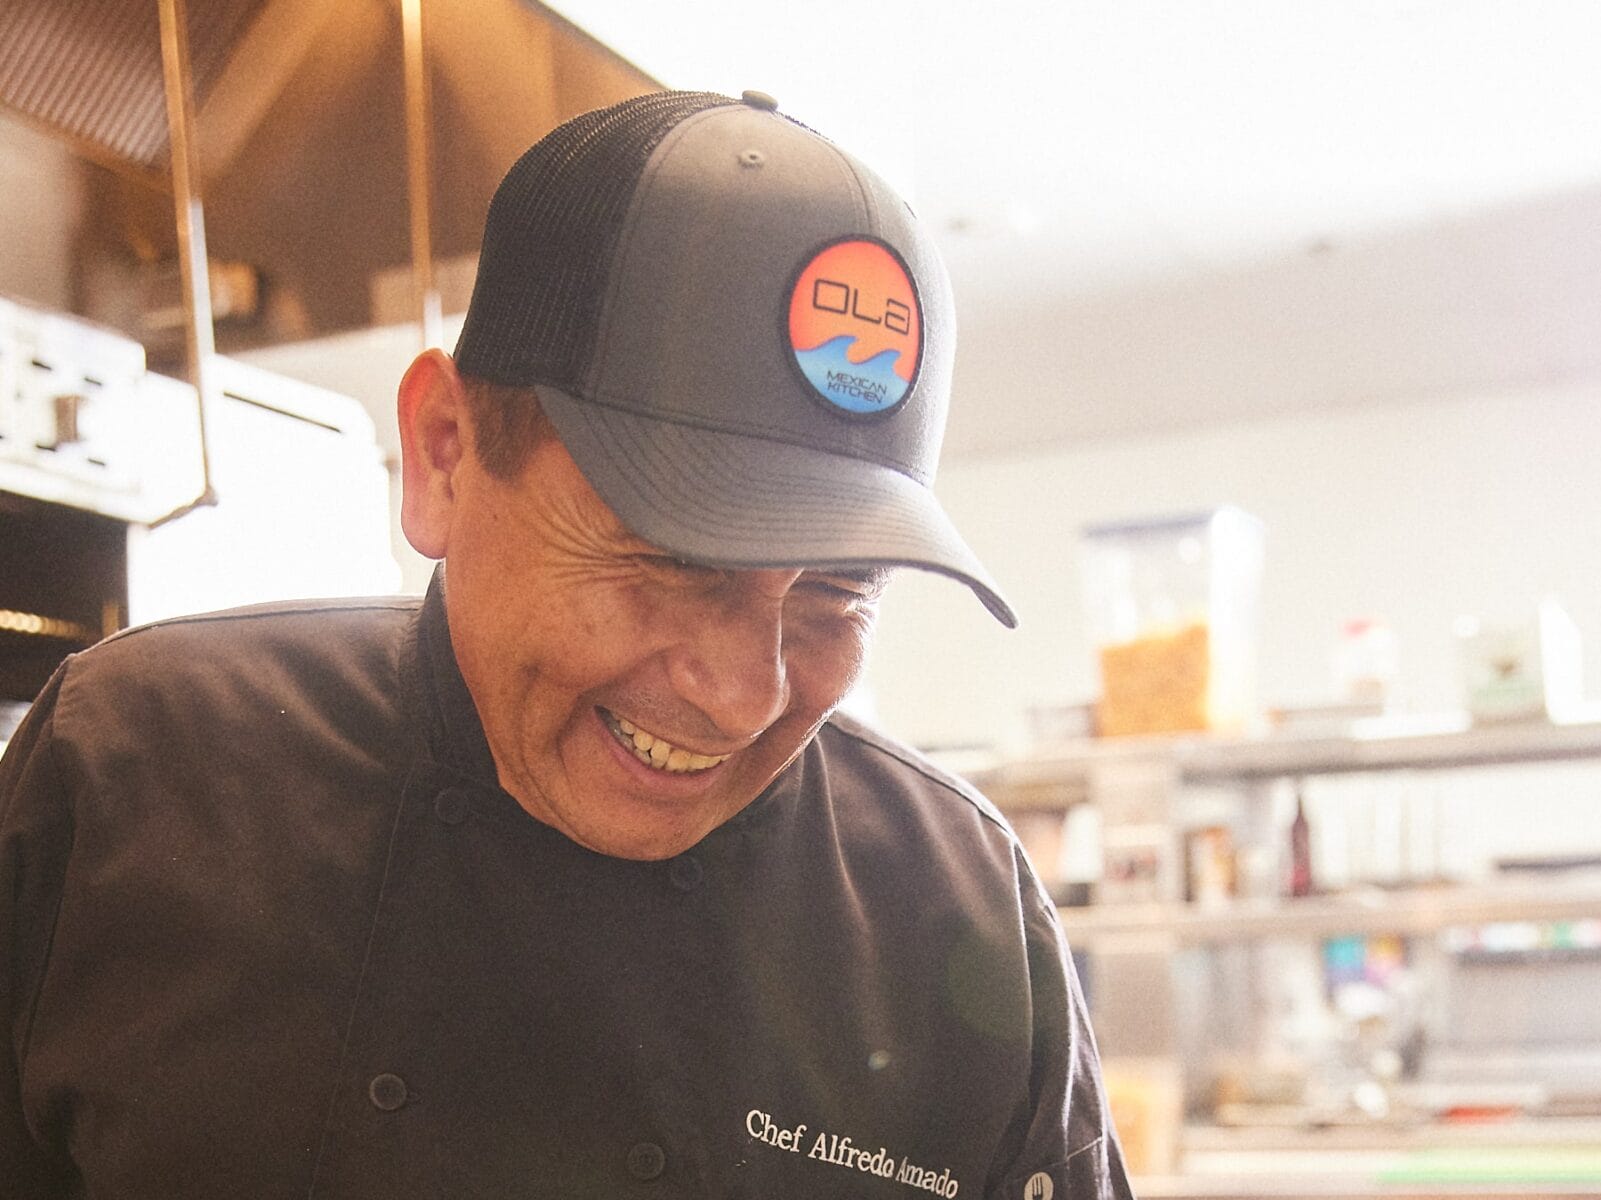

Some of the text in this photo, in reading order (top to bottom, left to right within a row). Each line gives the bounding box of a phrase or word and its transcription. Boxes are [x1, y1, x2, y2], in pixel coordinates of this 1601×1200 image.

[827, 370, 887, 395] MEXICAN
[828, 382, 883, 404] KITCHEN
[746, 1109, 959, 1199] Chef Alfredo Amado
